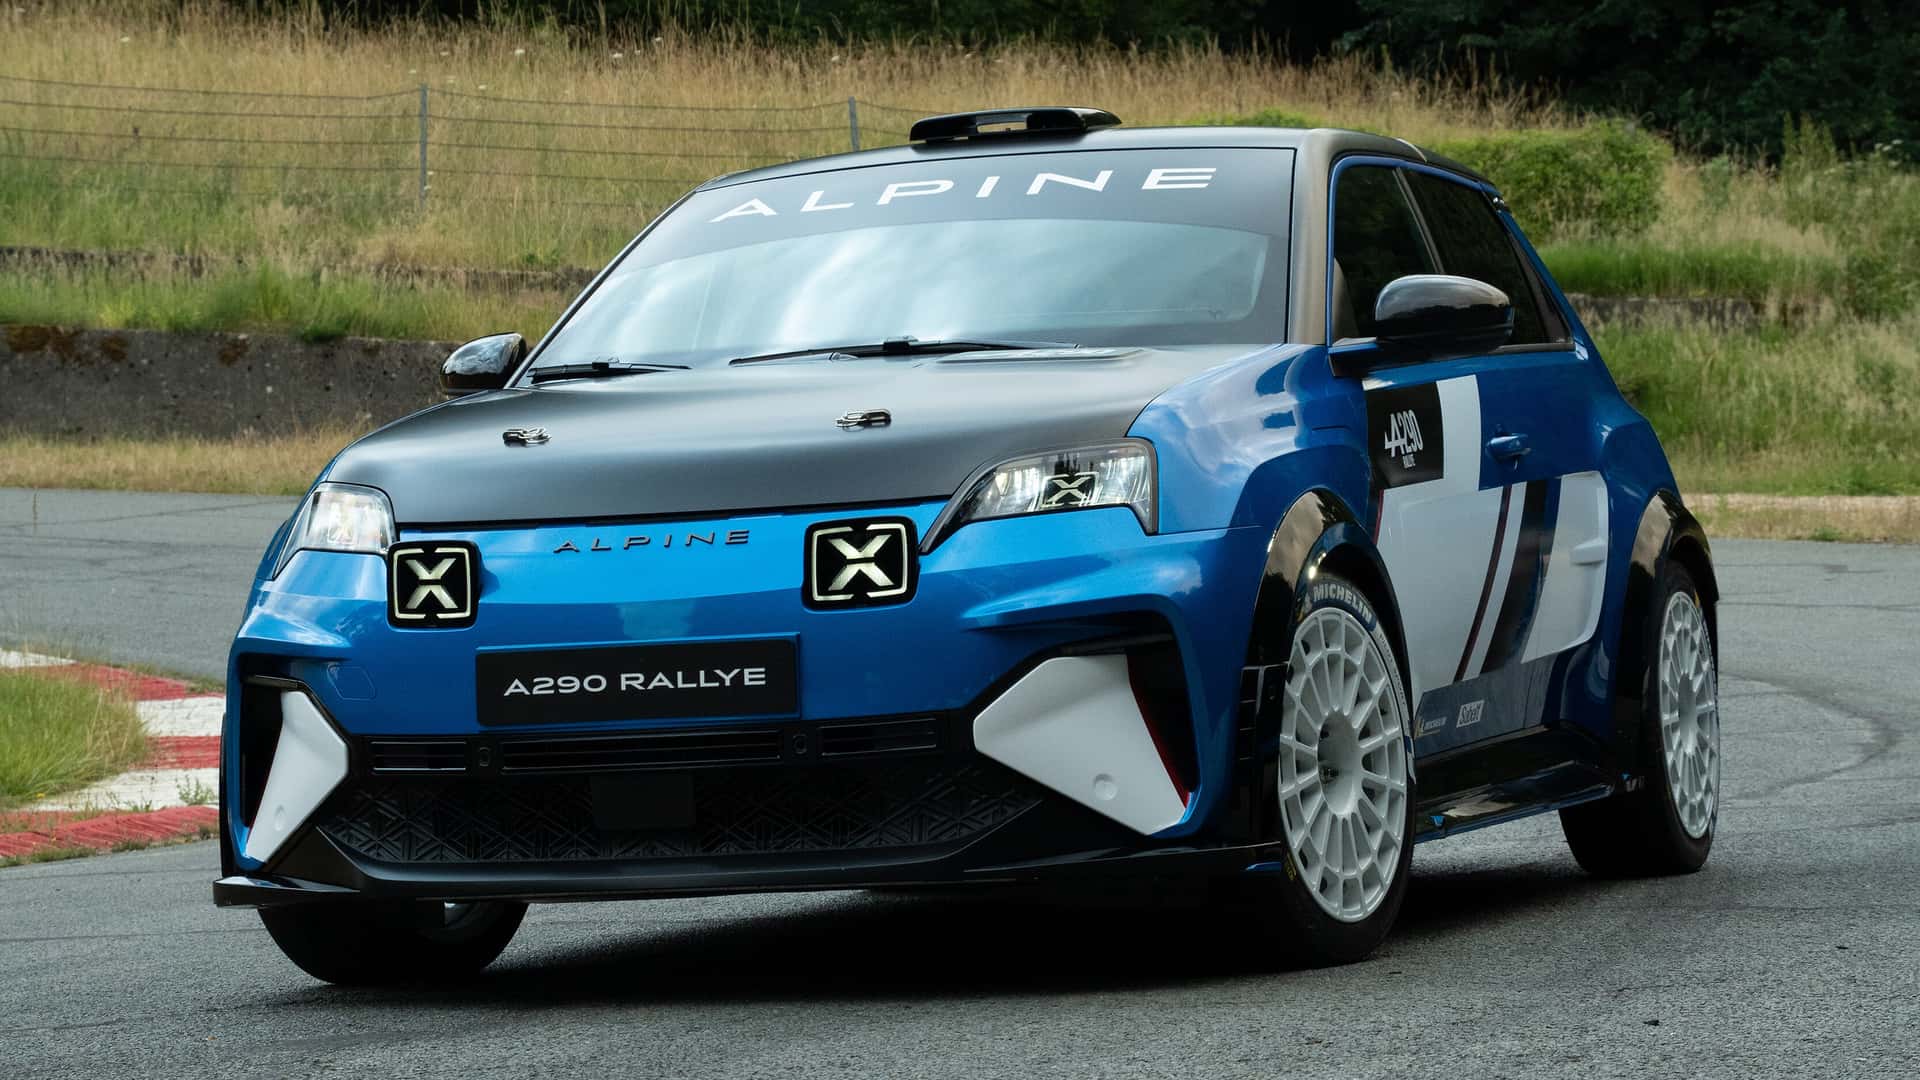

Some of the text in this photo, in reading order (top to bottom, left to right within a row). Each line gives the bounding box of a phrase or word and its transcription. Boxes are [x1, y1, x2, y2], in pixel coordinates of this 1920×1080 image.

[709, 167, 1217, 223] ALPINE
[553, 529, 751, 554] ALPINE
[1312, 583, 1374, 625] MICHELIN
[503, 666, 767, 697] A290 RALLYE
